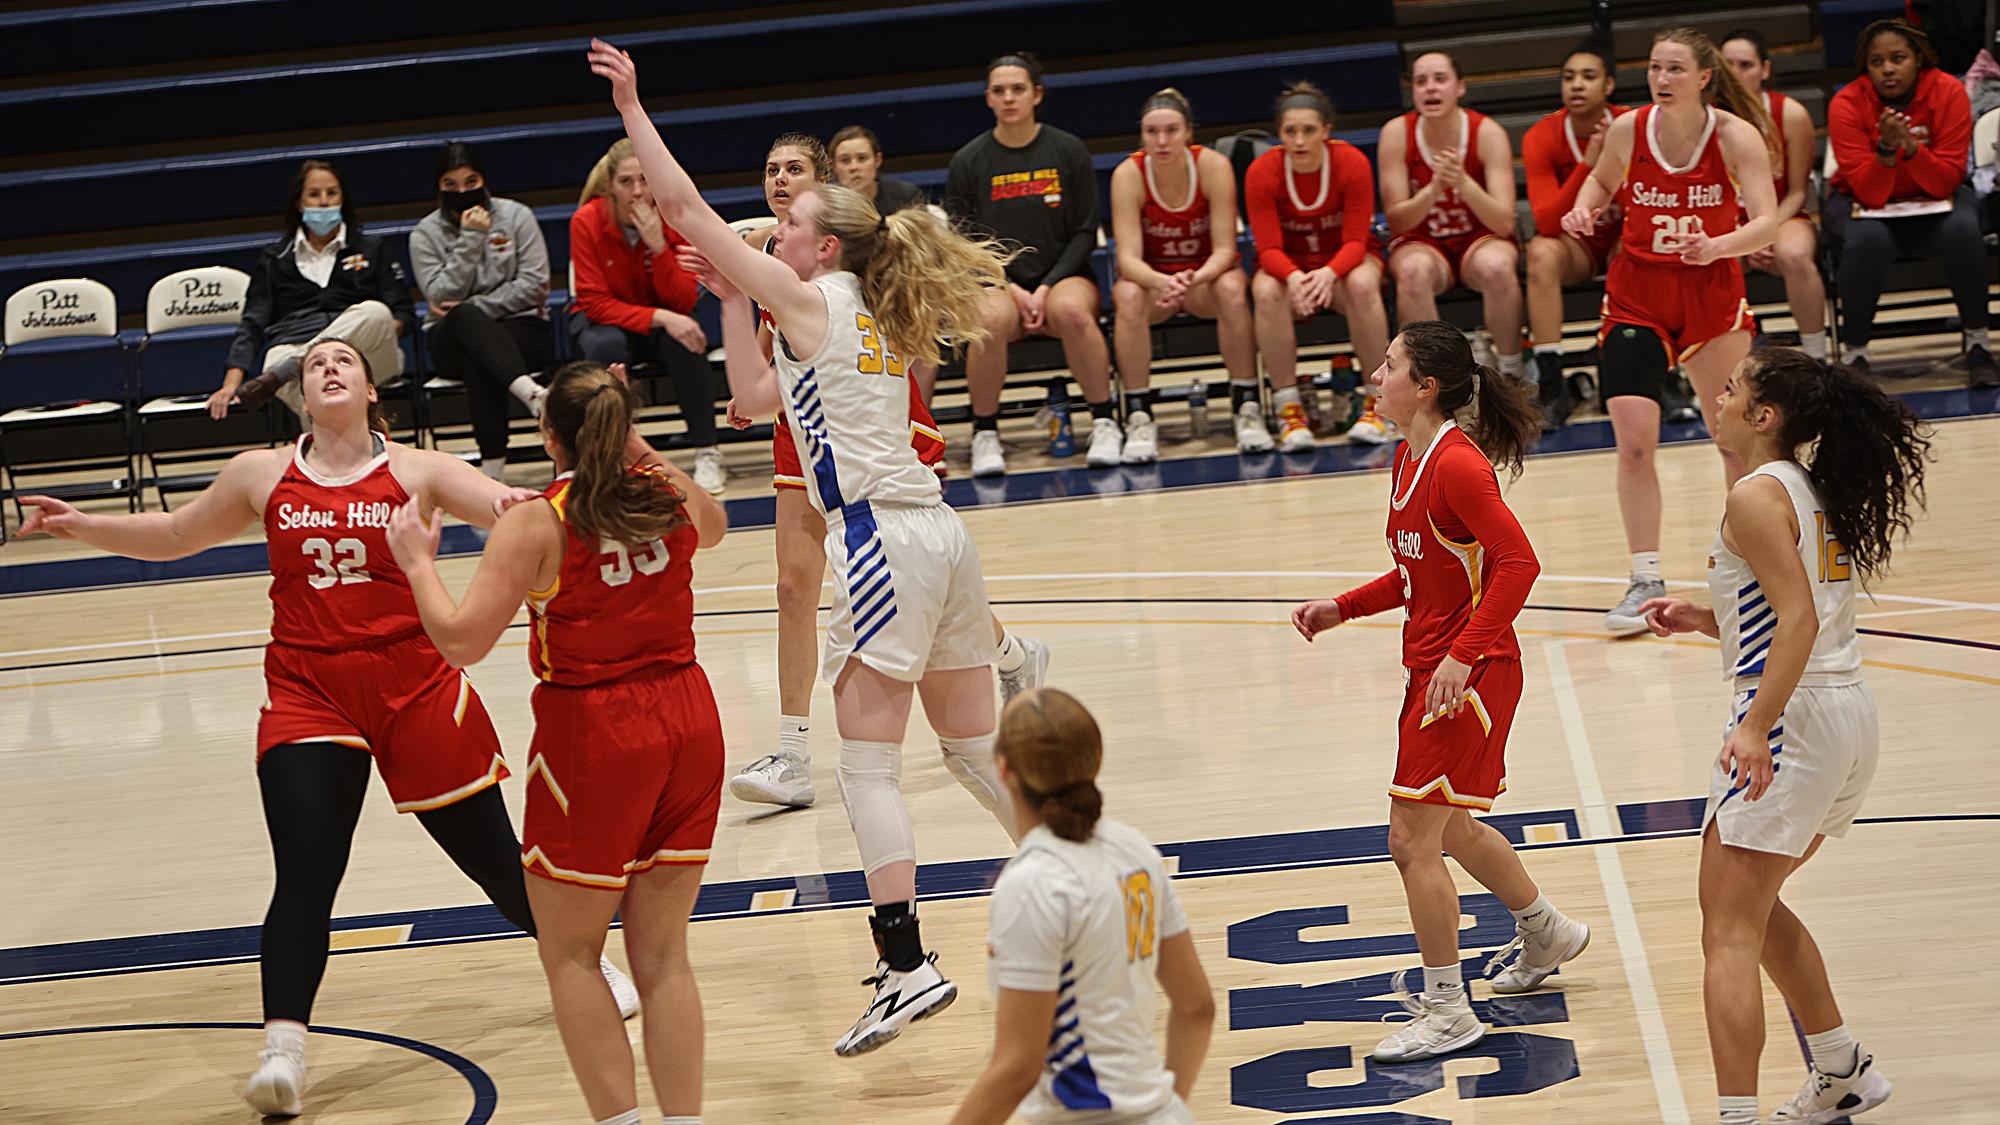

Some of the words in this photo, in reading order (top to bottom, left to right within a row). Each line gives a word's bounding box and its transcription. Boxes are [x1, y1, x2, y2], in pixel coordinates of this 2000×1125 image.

[1632, 182, 1680, 208] Seton
[1688, 183, 1723, 209] Hill
[36, 289, 81, 310] Pitt
[179, 277, 224, 298] Pitt
[22, 311, 97, 329] Johnstown
[165, 299, 240, 317] Johnstown
[278, 503, 338, 531] Seton
[346, 501, 392, 529] Hill
[1396, 529, 1424, 560] Hill
[301, 537, 373, 590] 32
[1227, 892, 1582, 1125] SAC
